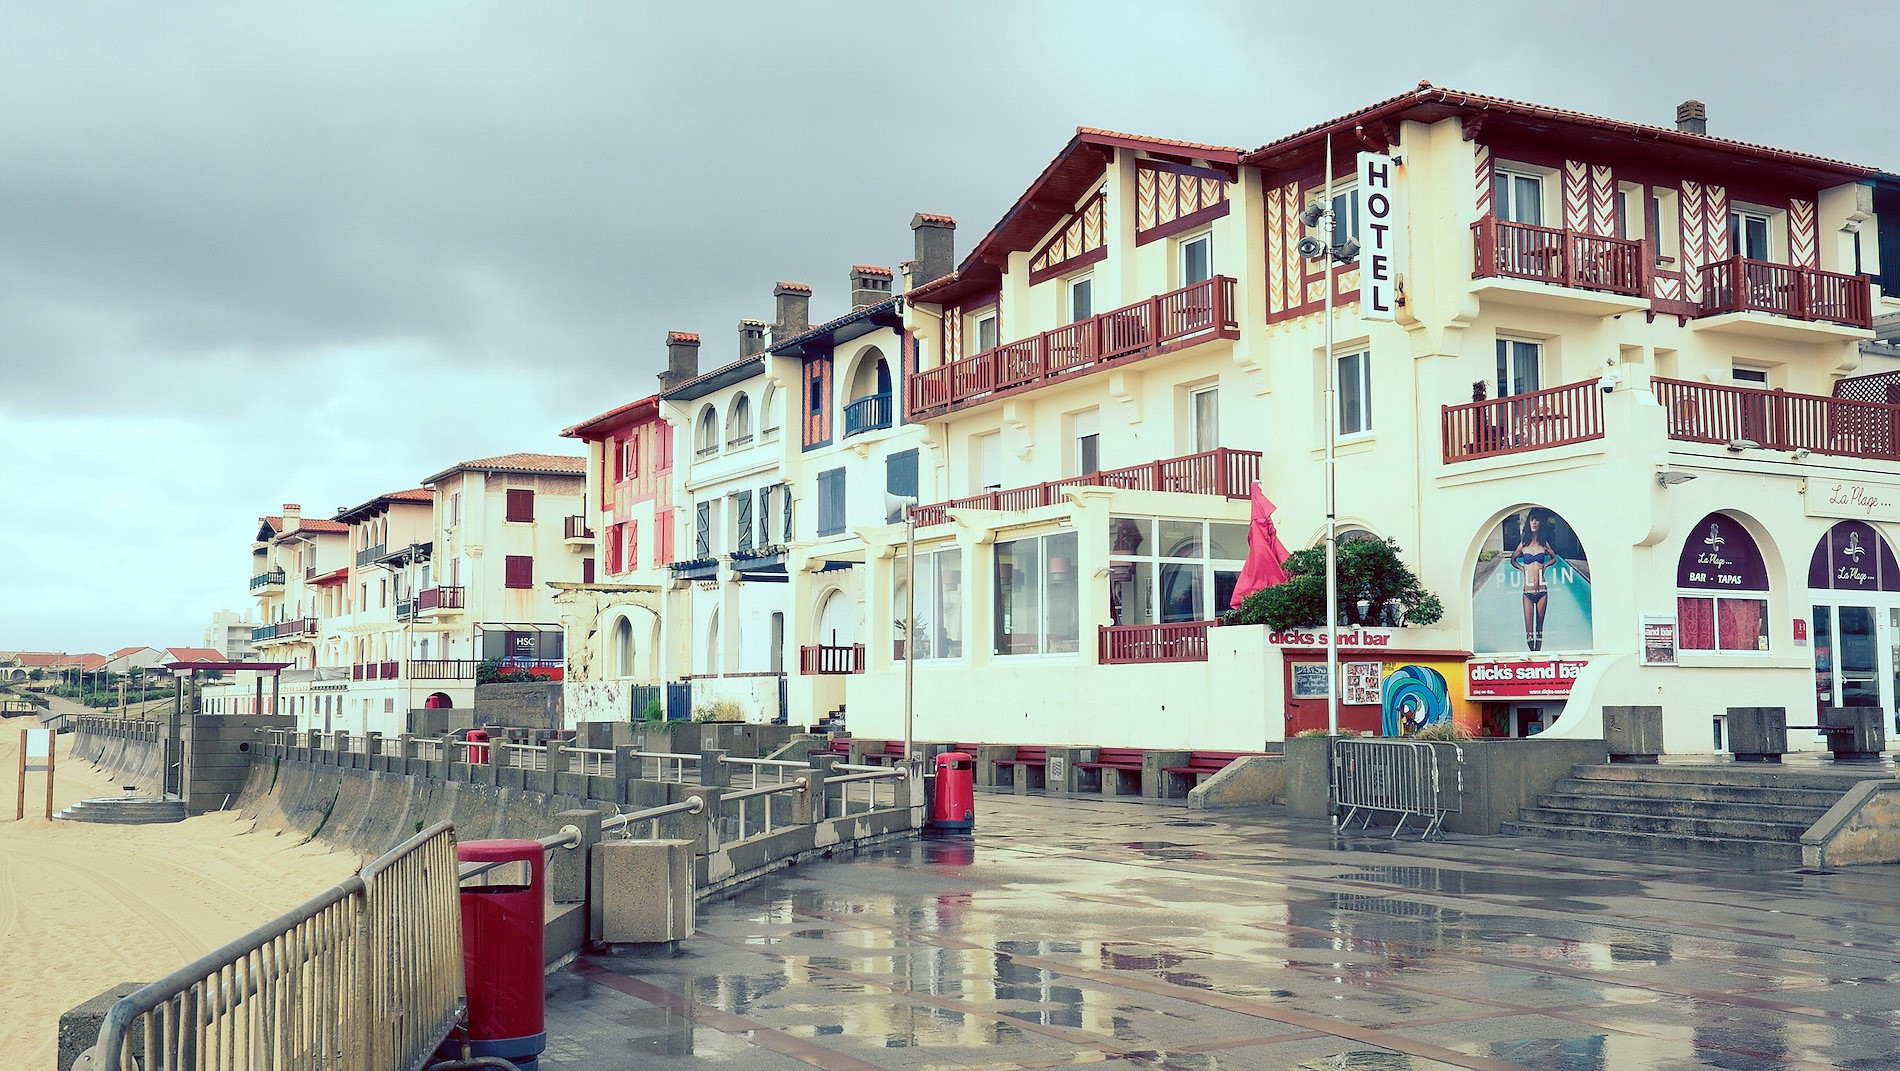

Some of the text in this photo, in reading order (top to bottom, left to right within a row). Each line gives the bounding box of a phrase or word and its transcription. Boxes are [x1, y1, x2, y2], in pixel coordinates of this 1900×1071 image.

[1368, 161, 1390, 312] HOTEL
[1829, 484, 1849, 505] La
[1697, 552, 1709, 564] La
[1495, 566, 1574, 589] PULLIN
[1689, 572, 1707, 583] BAR
[1717, 574, 1742, 585] TAPAS
[1837, 566, 1849, 580] La
[516, 637, 535, 646] HSC
[1268, 630, 1391, 646] dicks snd bar
[1471, 664, 1514, 681] dick's
[1516, 663, 1556, 680] sand
